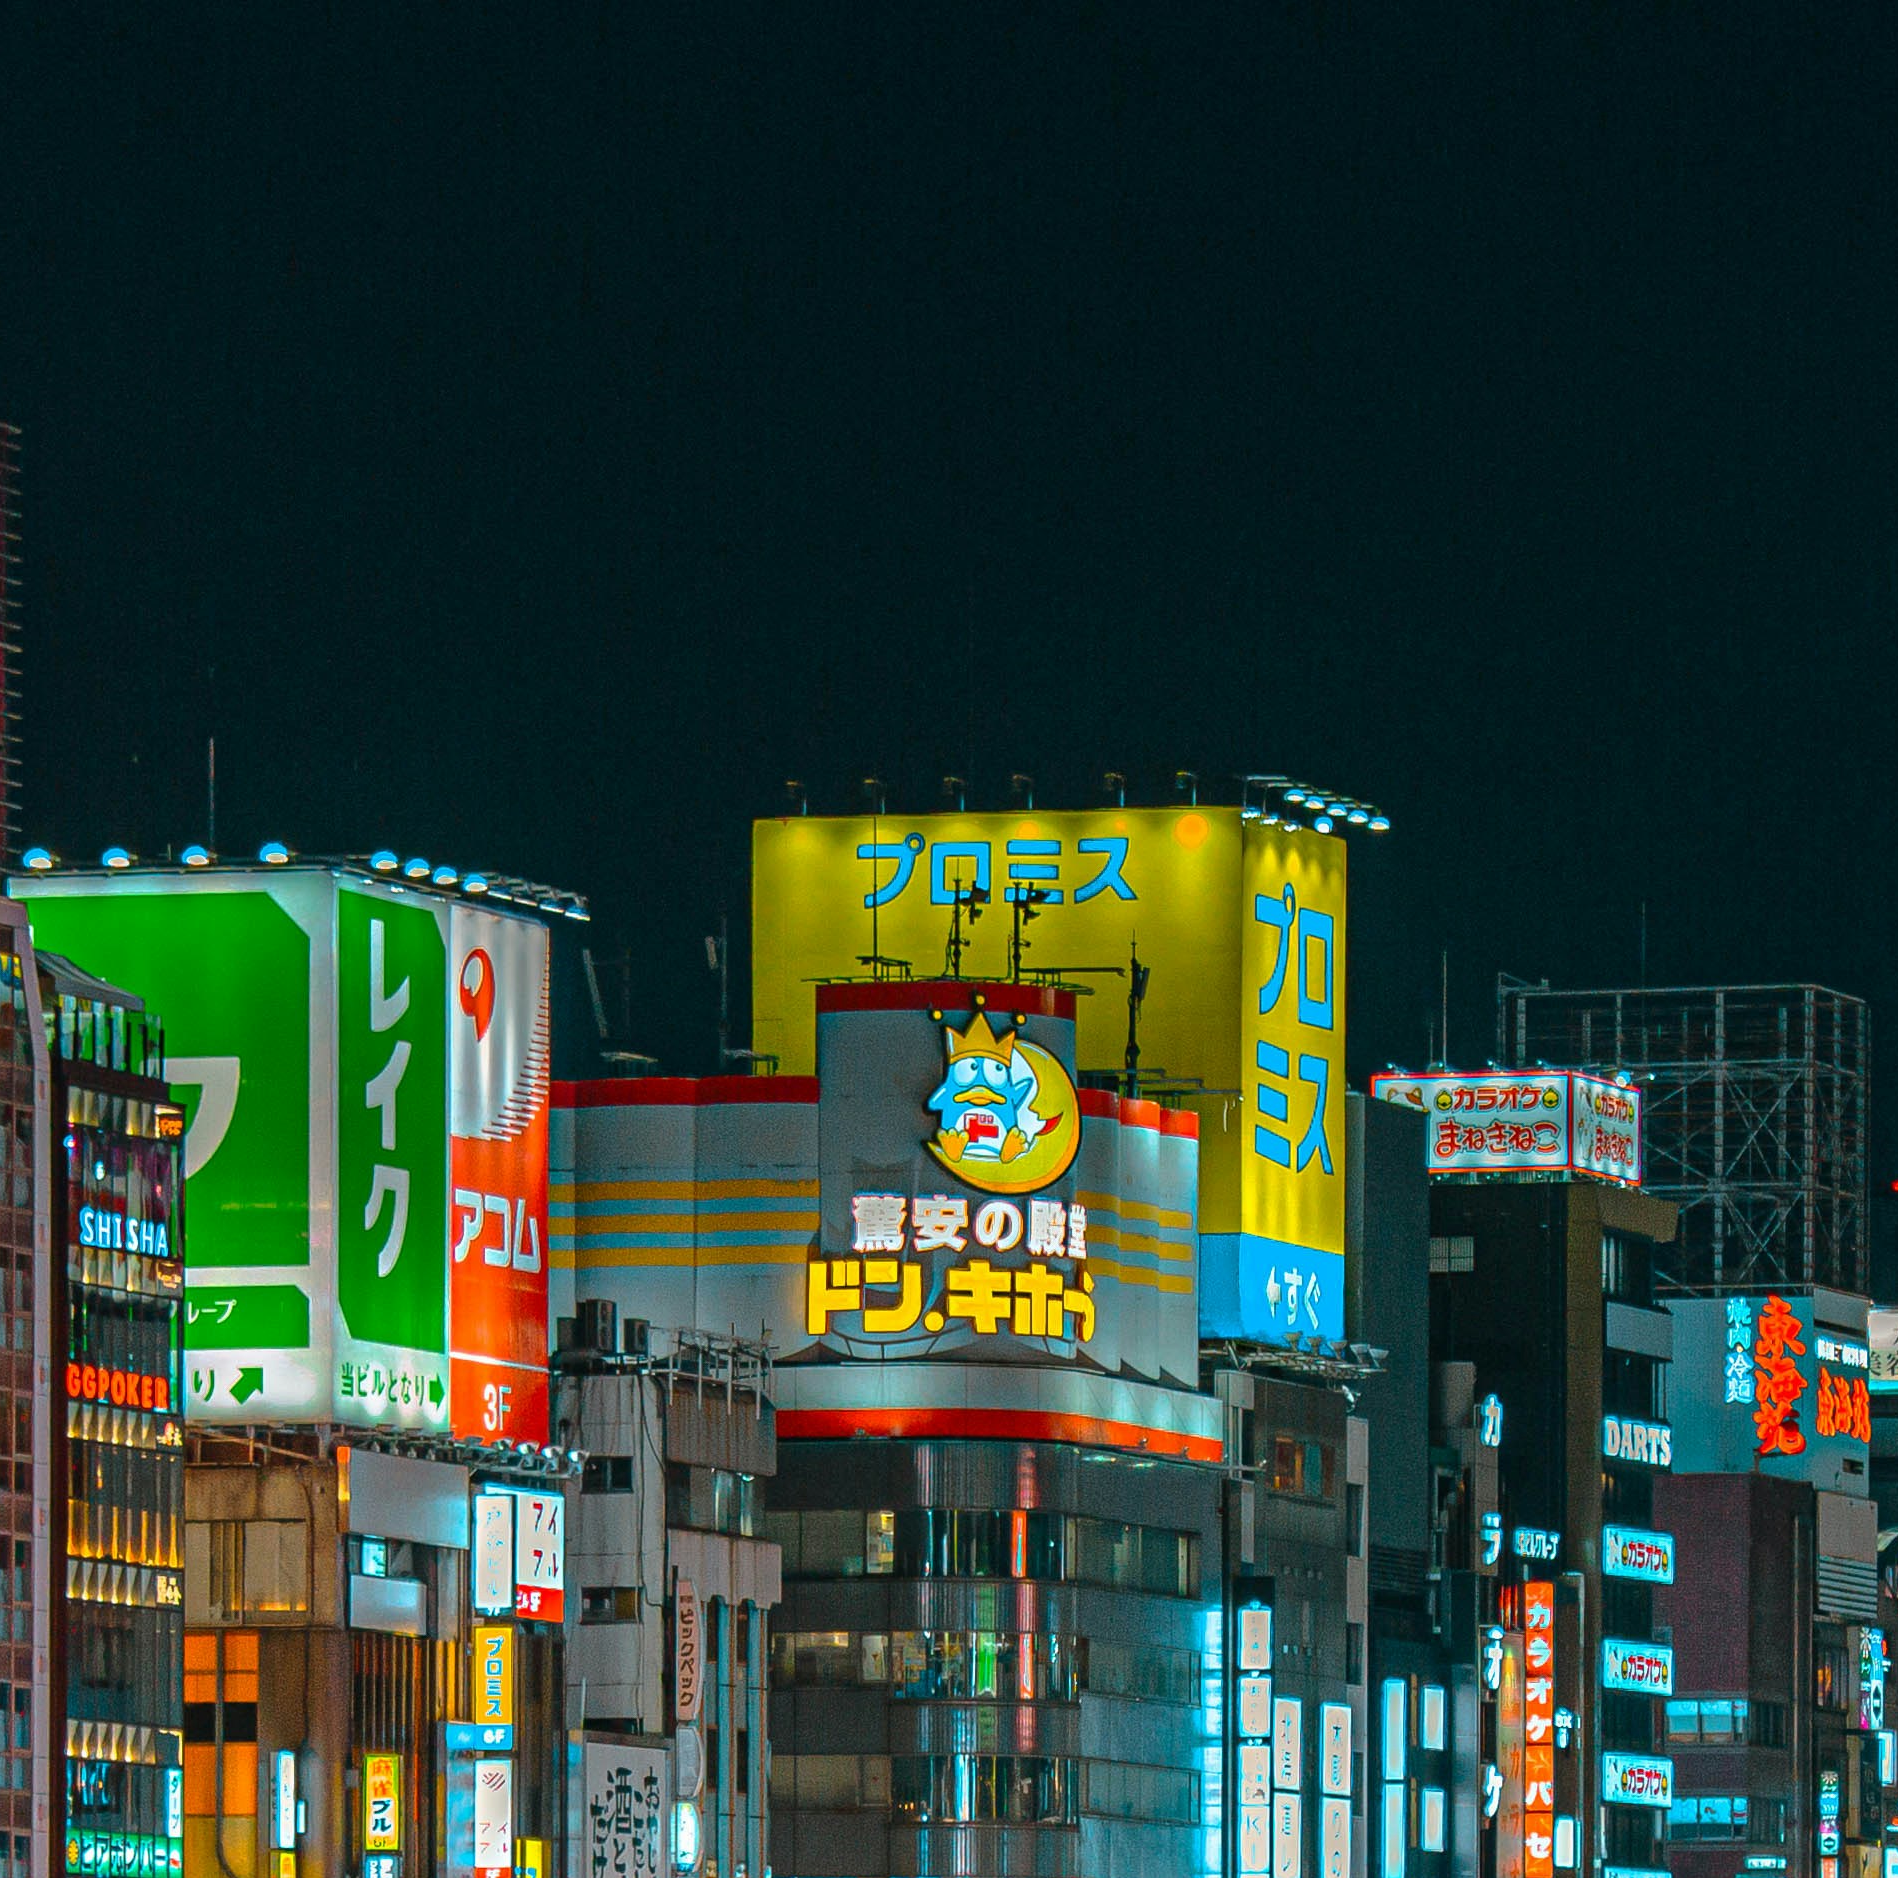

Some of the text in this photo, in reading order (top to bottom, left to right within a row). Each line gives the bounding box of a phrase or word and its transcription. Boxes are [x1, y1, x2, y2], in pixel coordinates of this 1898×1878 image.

[856, 833, 1138, 909] プロミス
[365, 919, 412, 1277] レイク
[1453, 1086, 1542, 1113] カラオケ
[1595, 1094, 1630, 1124] カラオケ
[1434, 1121, 1561, 1157] まねきねこ
[81, 1204, 169, 1257] SHISHA
[454, 1189, 541, 1274] アコム
[851, 1193, 1088, 1261] 驚安の殿堂
[1285, 1265, 1321, 1330] すぐ
[66, 1363, 170, 1411] GGPOKER
[340, 1361, 425, 1406] 当ビルとなり
[483, 1384, 512, 1431] 3F
[1605, 1417, 1672, 1468] DARTS
[1628, 1541, 1665, 1569] カラオケ
[487, 1637, 505, 1717] プロミス
[1527, 1602, 1552, 1742] カラオケ
[1628, 1655, 1663, 1682] カラオケ
[1628, 1768, 1663, 1795] カラオケ
